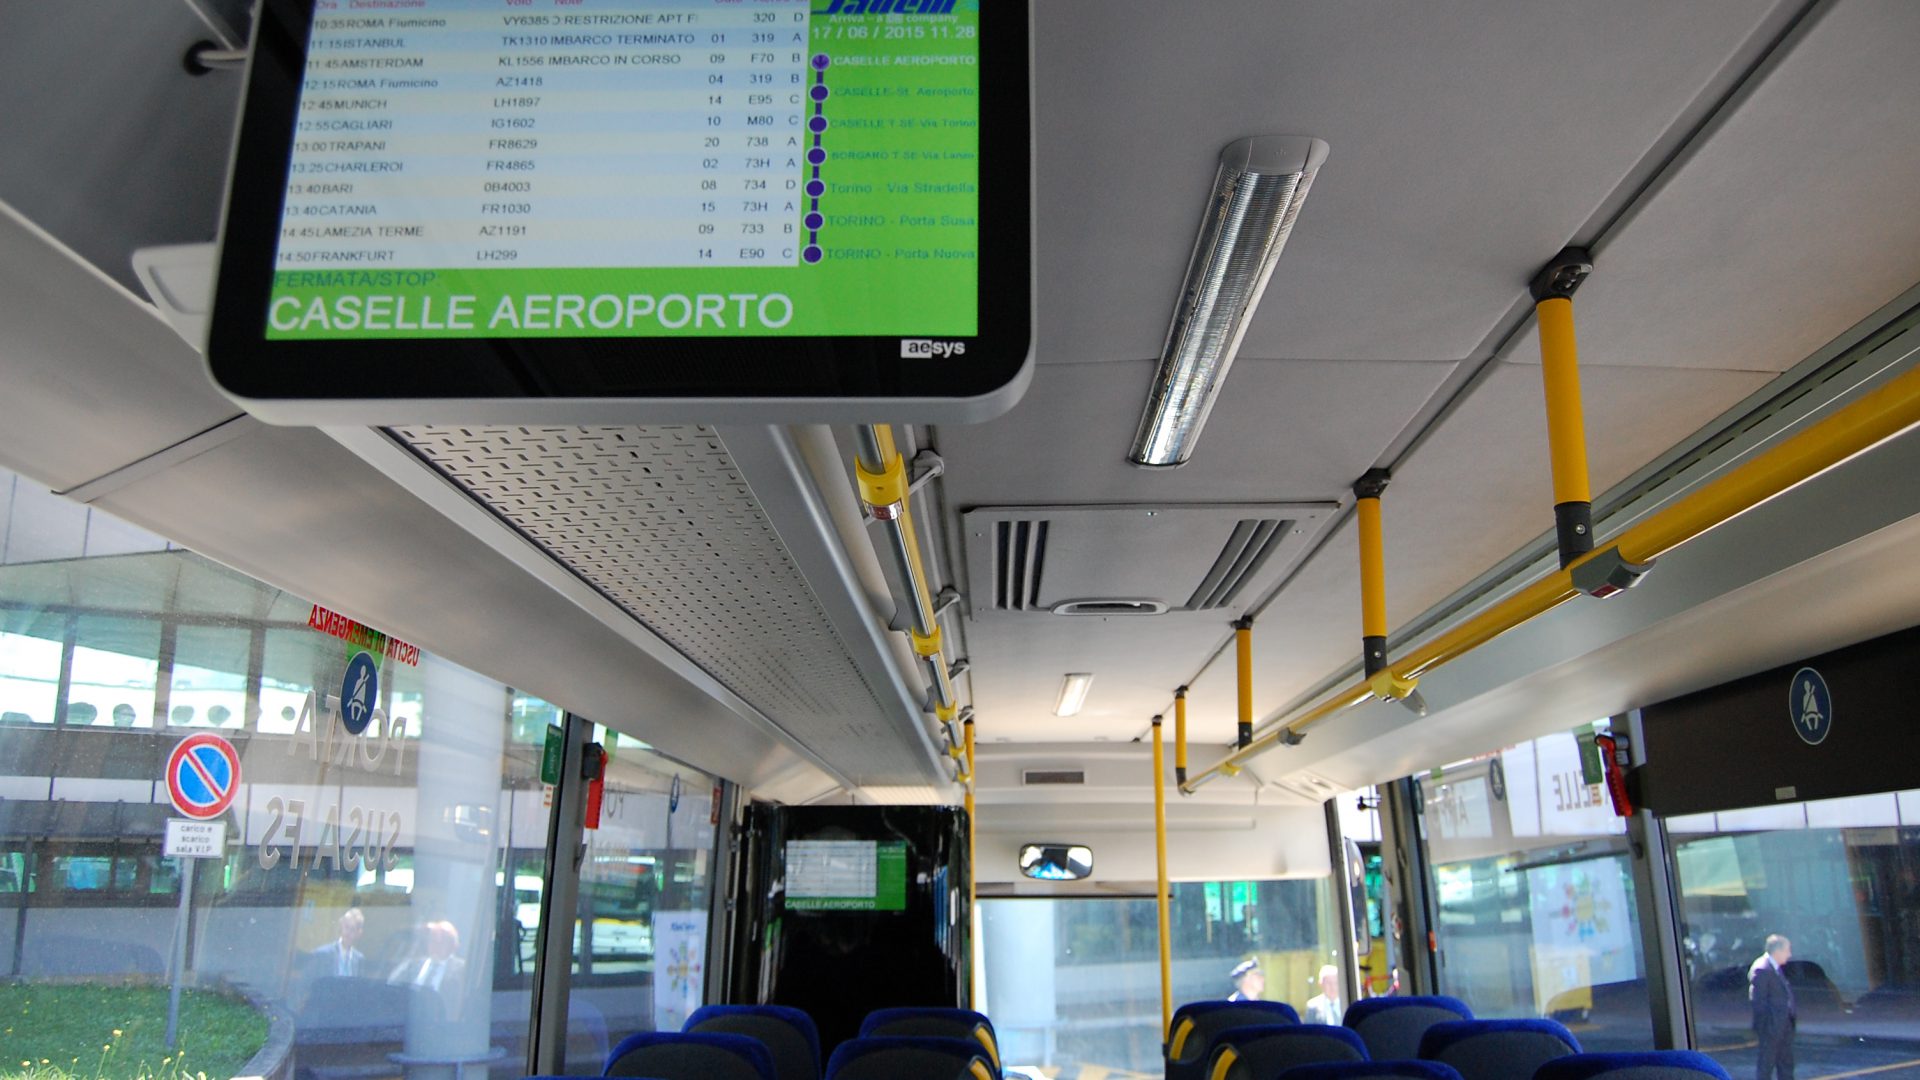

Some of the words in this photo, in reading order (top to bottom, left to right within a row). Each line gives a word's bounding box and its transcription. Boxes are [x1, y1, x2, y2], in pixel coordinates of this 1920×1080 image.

[346, 18, 385, 28] ROMA
[388, 18, 447, 28] Fiumicino
[503, 15, 549, 26] VY6385
[563, 14, 653, 26] RESTRIZIONE
[657, 14, 684, 24] APT
[753, 12, 776, 23] 320
[793, 12, 804, 22] D
[813, 26, 832, 39] 17
[848, 26, 868, 38] 06
[884, 26, 925, 38] 2015
[342, 38, 407, 49] ISTANBUL
[502, 35, 548, 46] TK1310
[550, 35, 612, 46] IMBARCO
[617, 34, 696, 44] TERMINATO
[711, 33, 725, 44] 01
[752, 32, 775, 43] 319
[792, 32, 802, 42] A
[340, 58, 424, 69] AMSTERDAM
[498, 56, 544, 66] KL1556
[548, 55, 611, 66] IMBARCO
[614, 54, 627, 65] IN
[631, 54, 682, 65] CORSO
[710, 54, 726, 64] 09
[751, 53, 775, 64] F70
[792, 52, 801, 63] B
[833, 55, 891, 66] CASELLE
[894, 54, 977, 66] AEROPORTO
[337, 79, 376, 90] ROMA
[380, 78, 439, 89] Fiumicino
[496, 76, 543, 88] AZ1418
[708, 74, 724, 84] 04
[750, 74, 773, 84] 319
[790, 74, 800, 84] B
[334, 99, 388, 110] MUNICH
[494, 97, 541, 108] LH1897
[709, 96, 722, 105] 14
[748, 94, 773, 106] E95
[789, 94, 800, 105] C
[330, 120, 393, 131] CAGLIARI
[491, 118, 536, 130] IG1602
[708, 116, 722, 126] 10
[747, 116, 774, 126] M80
[788, 115, 799, 126] C
[330, 140, 386, 152] TRAPANI
[489, 139, 538, 150] FR8629
[704, 137, 720, 148] 20
[747, 136, 769, 148] 738
[787, 136, 797, 147] A
[324, 162, 404, 173] CHARLEROI
[486, 160, 536, 172] FR4865
[702, 158, 719, 169] 02
[746, 158, 771, 168] 73H
[786, 158, 796, 168] A
[322, 184, 354, 194] BARI
[701, 180, 718, 190] 08
[744, 180, 767, 190] 734
[786, 180, 796, 190] D
[830, 182, 873, 194] Torino
[886, 182, 909, 194] Via
[914, 182, 976, 194] Stradella
[318, 204, 378, 216] CATANIA
[482, 203, 532, 214] FR1030
[702, 202, 716, 213] 15
[743, 202, 769, 212] 73H
[784, 202, 794, 212] A
[828, 215, 886, 226] TORINO
[899, 214, 936, 226] Porta
[315, 226, 374, 238] LAMEZIA
[378, 226, 424, 237] TERME
[479, 225, 527, 236] AZ1191
[698, 224, 715, 234] 09
[742, 224, 765, 234] 733
[784, 223, 793, 234] B
[312, 250, 396, 262] FRANKFURT
[476, 250, 518, 261] LH299
[698, 248, 713, 259] 14
[740, 248, 766, 260] E90
[782, 248, 793, 259] C
[826, 248, 882, 260] TORINO
[894, 248, 930, 260] Porta
[933, 248, 976, 260] Nuova
[269, 294, 477, 331] CASELLE
[488, 293, 794, 330] AEROPORTO
[906, 341, 966, 358] aesys
